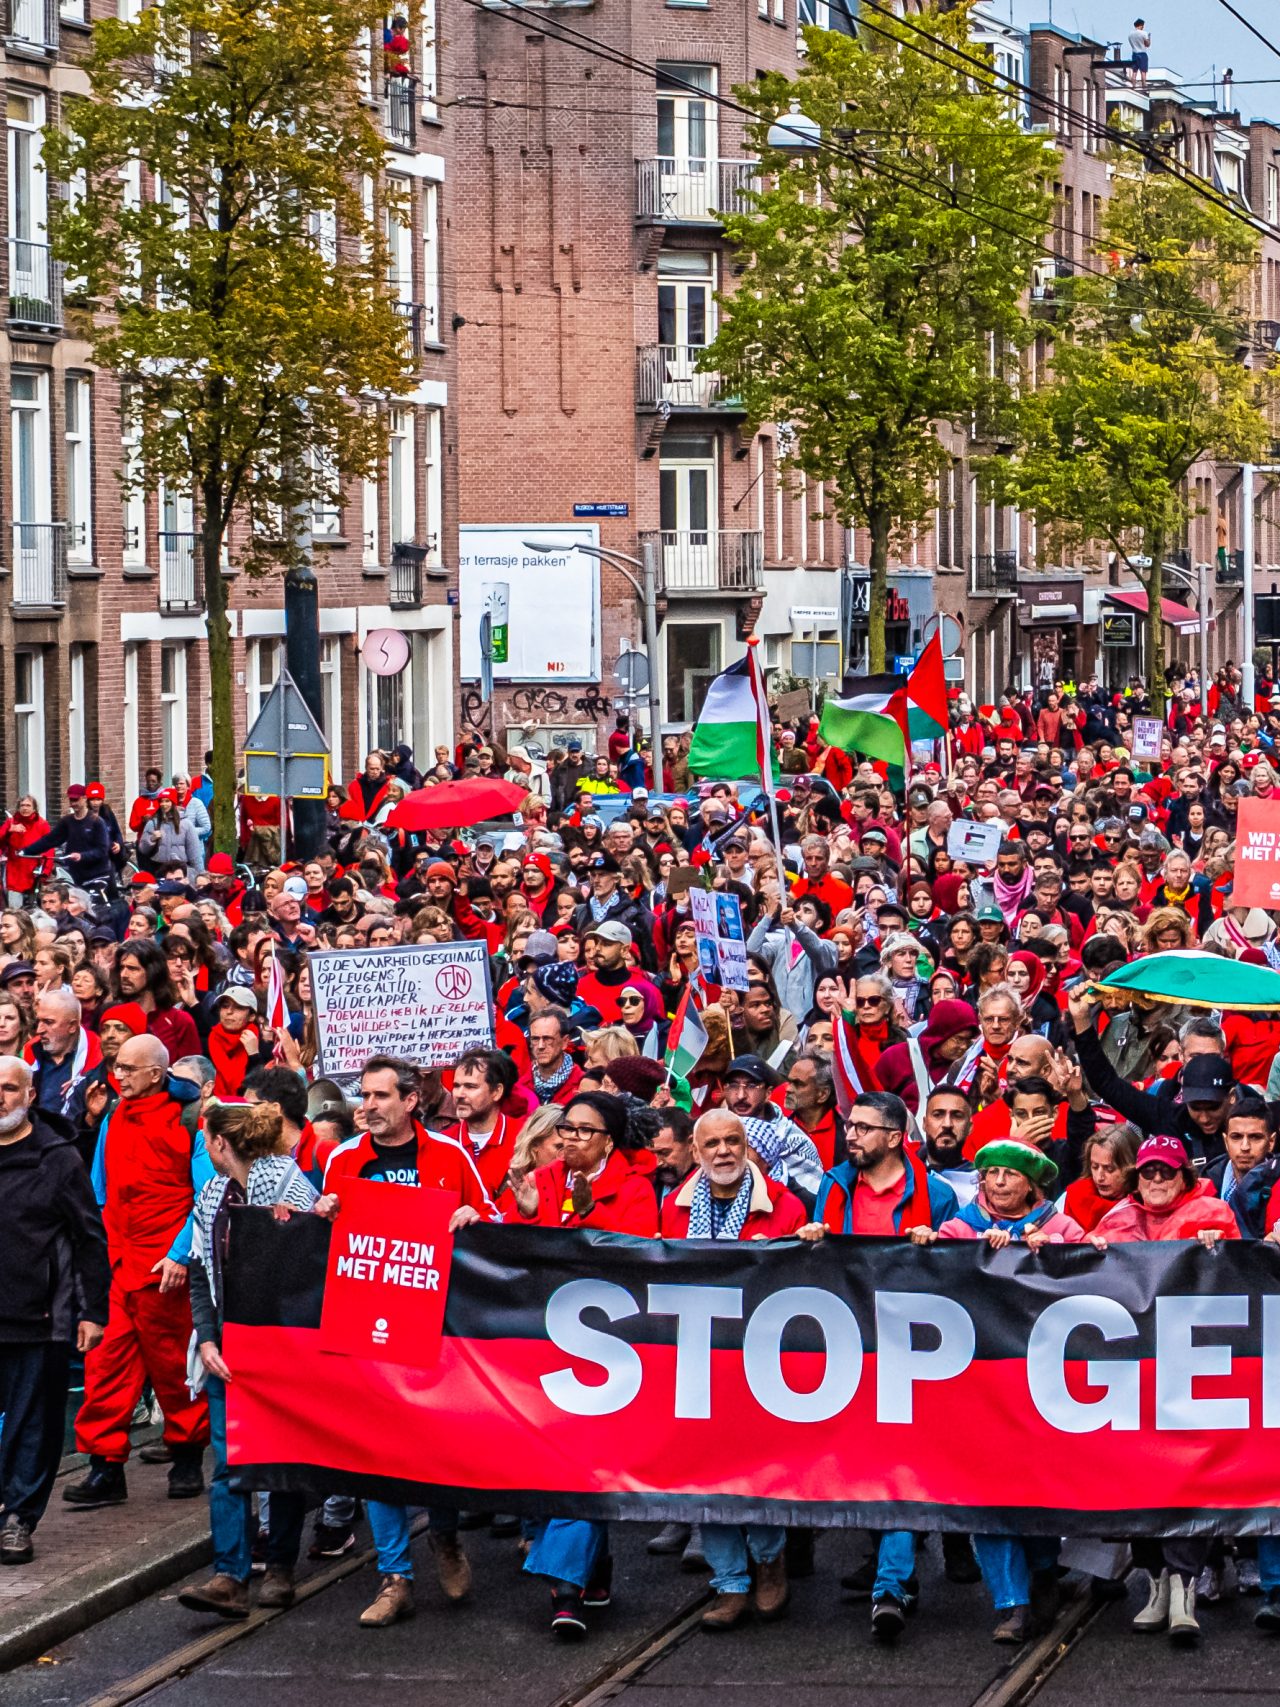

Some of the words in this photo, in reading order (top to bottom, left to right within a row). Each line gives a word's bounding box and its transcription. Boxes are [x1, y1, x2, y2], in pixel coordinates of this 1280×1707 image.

[474, 555, 518, 568] terrasje
[1248, 832, 1275, 847] WIJ
[1242, 846, 1272, 861] MET
[318, 959, 330, 972] IS
[333, 959, 350, 971] DE
[353, 955, 420, 969] WAARHEID
[318, 972, 336, 984] OP
[345, 983, 372, 995] ZEG
[326, 1021, 347, 1034] ALS
[351, 1019, 400, 1032] WILDERS
[411, 1016, 442, 1030] LAAT
[462, 1015, 478, 1025] ME
[327, 1033, 364, 1048] ALTIJD
[323, 1048, 337, 1059] EN
[338, 1046, 373, 1058] TRUMP
[400, 1043, 418, 1054] DAT
[325, 1060, 342, 1072] DAT
[349, 1232, 386, 1259] WIJ
[389, 1240, 435, 1266] ZIJN
[336, 1255, 380, 1281] MET
[383, 1262, 440, 1291] MEER
[539, 1278, 976, 1424] STOP
